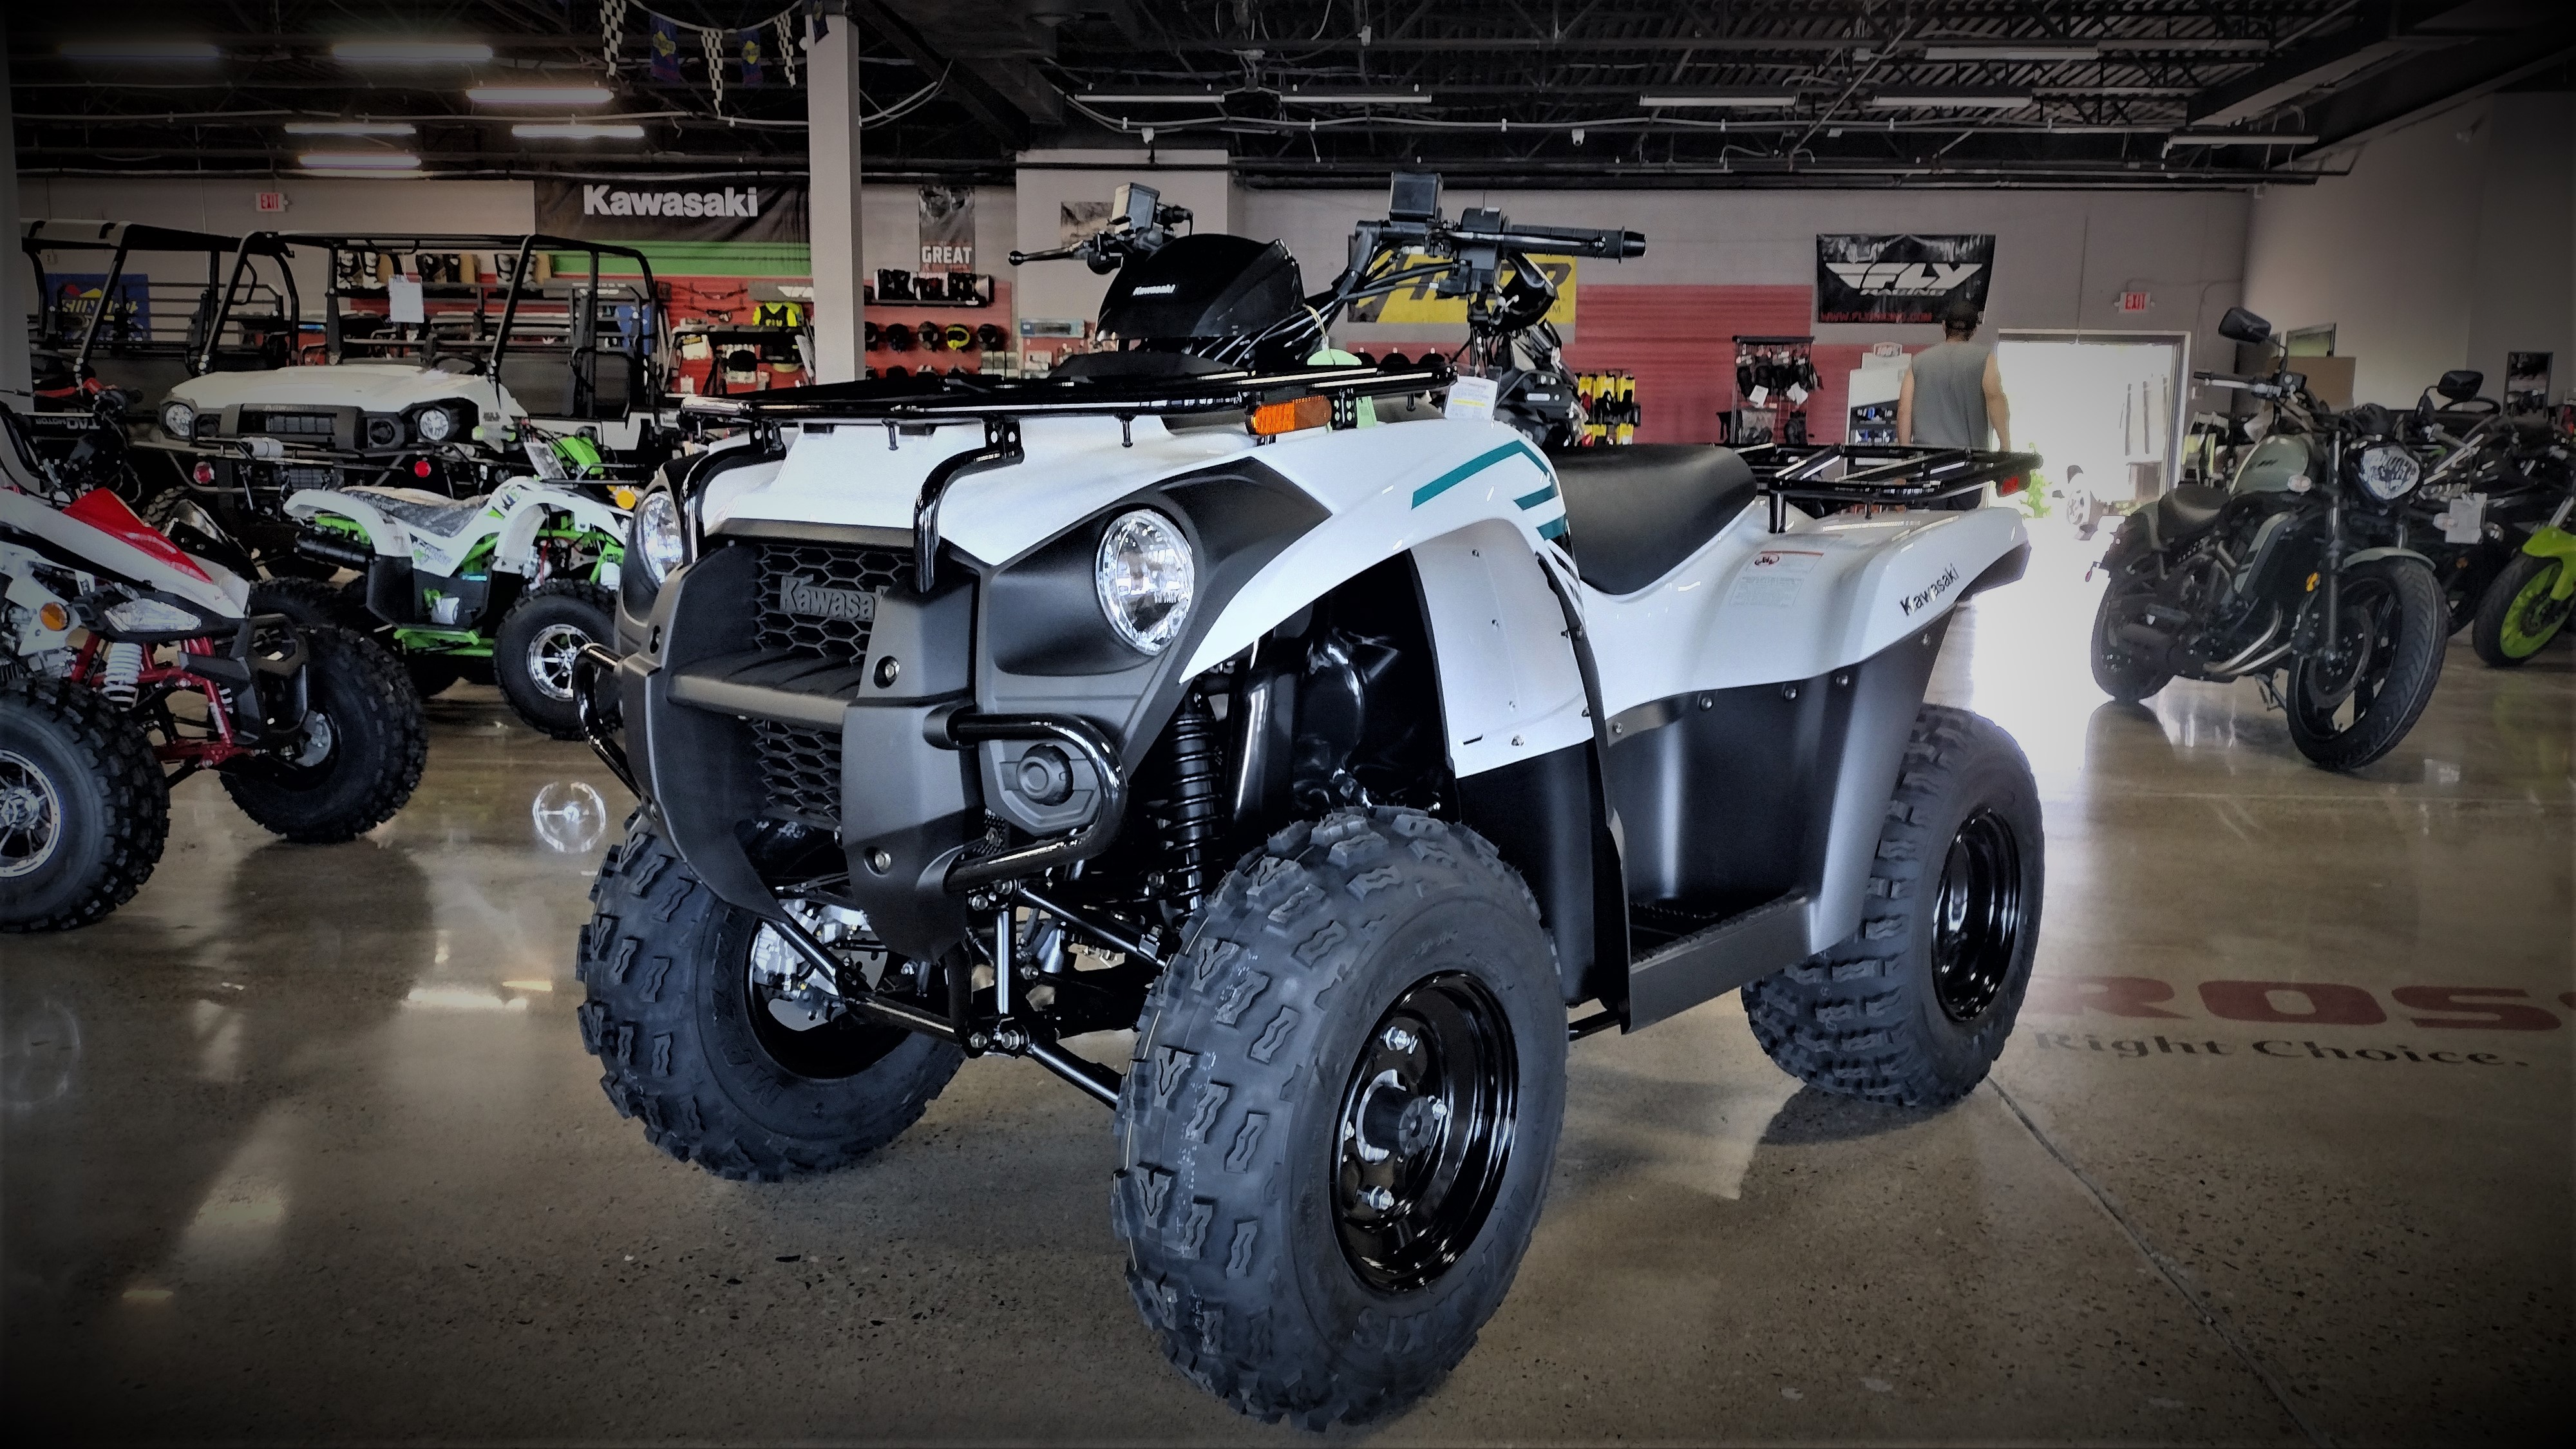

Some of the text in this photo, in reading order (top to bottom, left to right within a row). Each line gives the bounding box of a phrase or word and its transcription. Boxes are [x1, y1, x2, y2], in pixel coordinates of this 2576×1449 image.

[261, 194, 279, 209] EXIT
[583, 184, 759, 218] Kawasaki
[922, 246, 972, 264] GREAT
[1826, 262, 1984, 289] FLY
[2125, 293, 2146, 310] EXIT
[66, 417, 100, 430] TAO
[780, 574, 890, 622] Kawasa
[1900, 563, 1959, 616] Kawasaki
[2026, 976, 2576, 1030] ROS
[2034, 1032, 2528, 1066] Right Choice.
